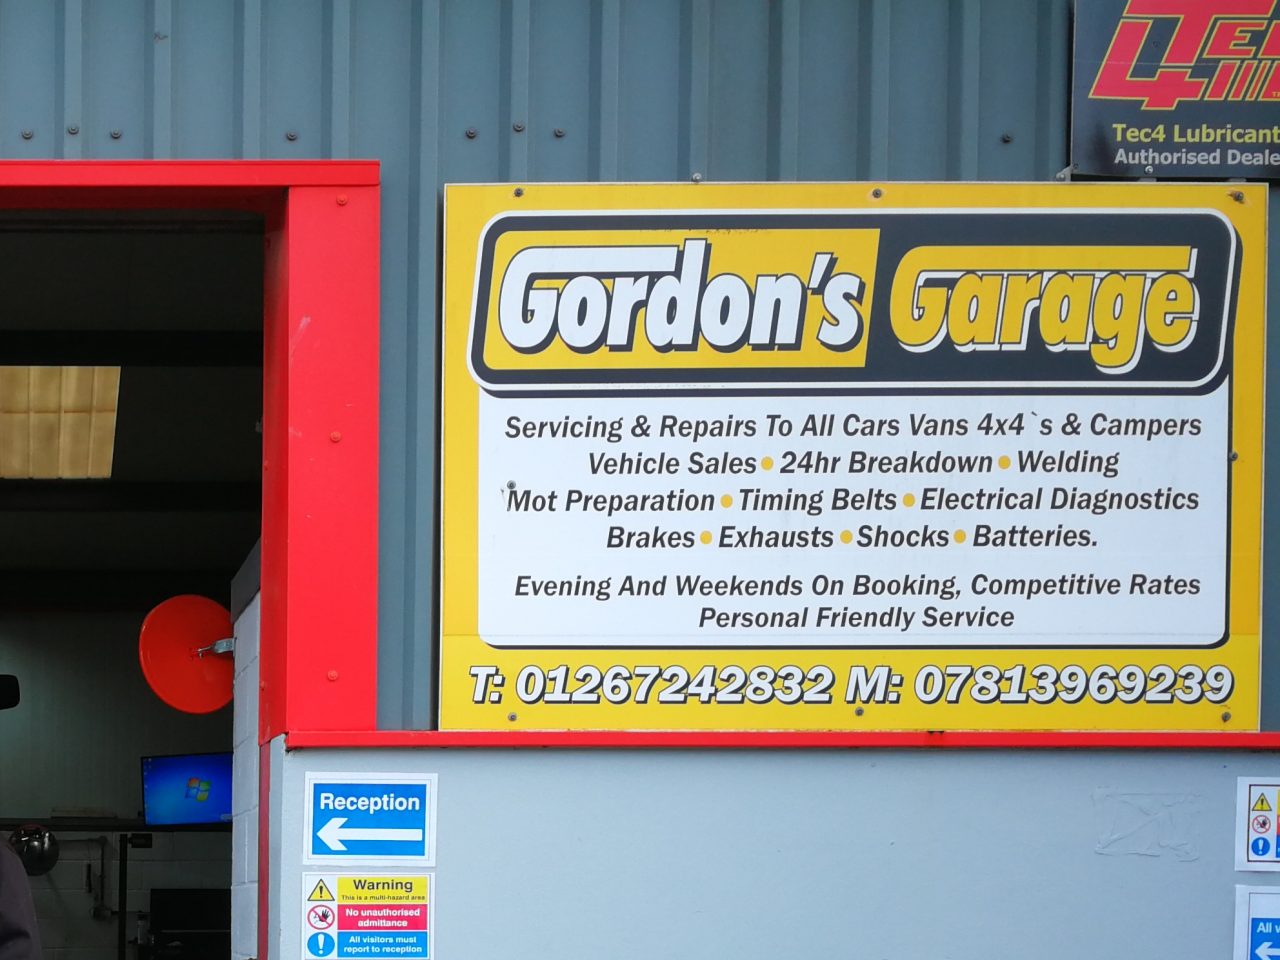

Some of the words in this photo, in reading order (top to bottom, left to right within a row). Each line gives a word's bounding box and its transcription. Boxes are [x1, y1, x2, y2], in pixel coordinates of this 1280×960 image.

[1113, 124, 1166, 142] Tec4
[1174, 124, 1280, 143] Lubricant
[1114, 149, 1220, 165] Authorised
[499, 238, 864, 353] Gordon's
[890, 246, 1200, 374] Garage
[505, 415, 623, 442] Servicing
[631, 416, 650, 437] &
[660, 415, 756, 442] Repairs
[767, 415, 792, 437] To
[801, 415, 834, 436] All
[844, 414, 900, 437] Cars
[911, 414, 968, 436] Vans
[1062, 413, 1081, 436] &
[1091, 413, 1201, 440] Campers
[589, 452, 680, 474] Vehicle
[688, 452, 756, 474] Sales
[780, 451, 840, 473] 24hr
[849, 451, 993, 473] Breakdown
[1019, 451, 1120, 477] Welding
[507, 489, 557, 511] Mot
[566, 489, 715, 516] Preparation
[740, 489, 823, 515] Timing
[832, 489, 897, 511] Belts
[921, 488, 1042, 510] Electrical
[1051, 487, 1199, 514] Diagnostics
[607, 526, 695, 548] Brakes
[719, 526, 834, 547] Exhausts
[857, 525, 949, 547] Shocks
[973, 525, 1097, 547] Batteries.
[516, 575, 611, 600] Evening
[618, 575, 667, 596] And
[677, 575, 803, 596] Weekends
[812, 575, 844, 596] On
[853, 575, 961, 601] Booking,
[971, 574, 1121, 599] Competitive
[1130, 574, 1201, 595] Rates
[699, 608, 808, 628] Personal
[817, 607, 915, 631] Friendly
[923, 607, 1015, 627] Service
[469, 666, 505, 704] T:
[515, 665, 835, 704] 01267242832
[845, 665, 903, 704] M:
[914, 664, 1234, 704] 07813969239
[320, 793, 420, 814] Reception
[353, 879, 413, 893] Warning
[345, 908, 359, 917] No
[361, 908, 421, 917] unauthorised
[358, 918, 408, 927] admittance
[1257, 921, 1272, 934] All
[344, 945, 369, 955] report
[371, 945, 380, 953] to
[382, 945, 423, 955] reception
[349, 935, 361, 944] All
[362, 935, 394, 944] visitors
[395, 936, 417, 944] must
